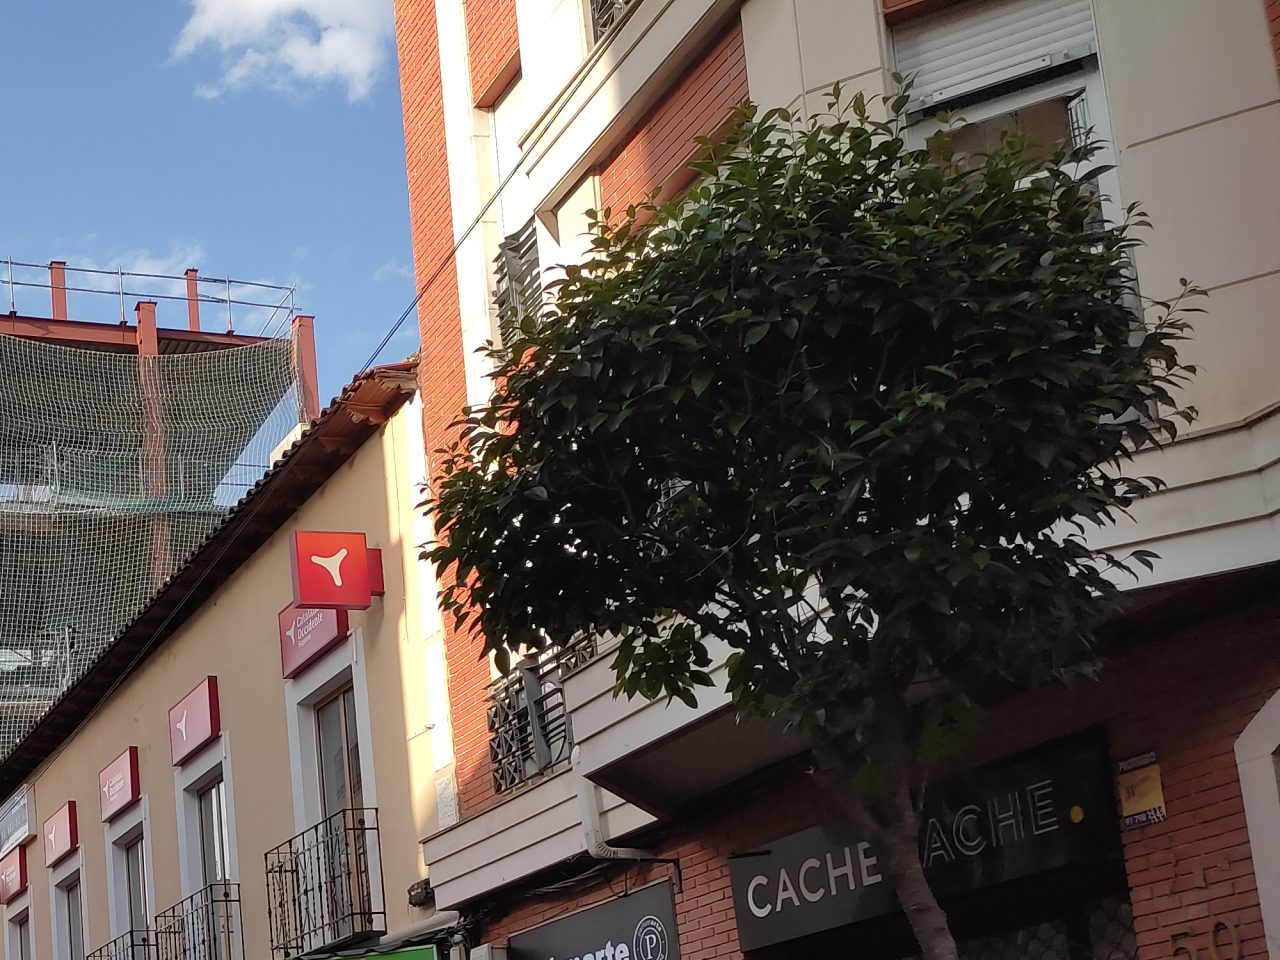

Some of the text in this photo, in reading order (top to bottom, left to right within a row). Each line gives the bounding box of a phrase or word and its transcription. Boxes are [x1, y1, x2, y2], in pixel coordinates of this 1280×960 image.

[297, 612, 324, 639] Occidente
[746, 779, 1059, 918] CACHE ACHE
[644, 934, 657, 960] P
